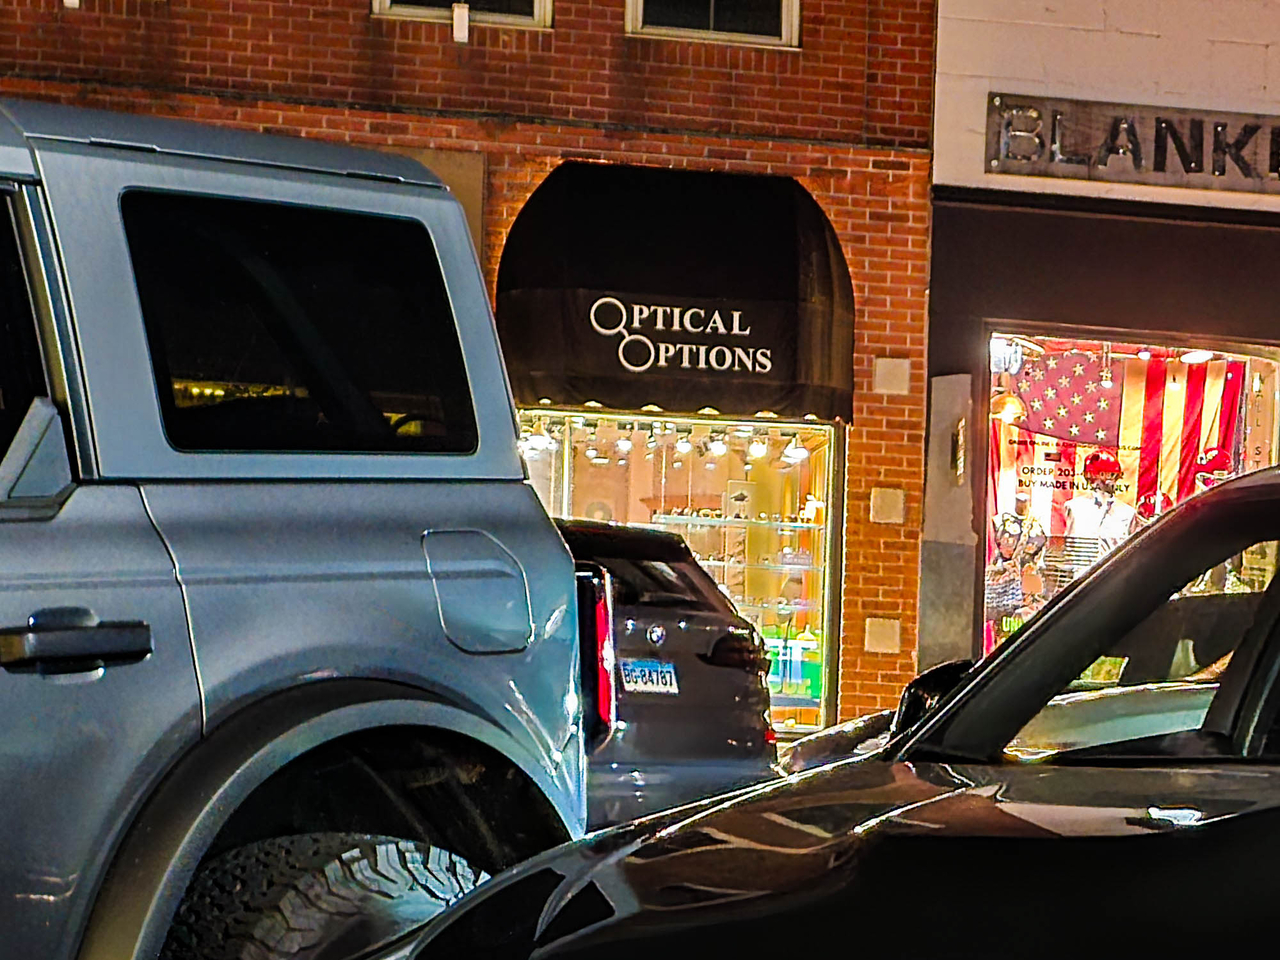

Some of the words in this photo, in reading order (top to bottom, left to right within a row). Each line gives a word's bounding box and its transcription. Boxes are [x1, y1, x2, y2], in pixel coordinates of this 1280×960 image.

[590, 297, 751, 336] OPTICAL
[618, 334, 773, 374] OPTIONS
[1018, 478, 1037, 488] BUY
[1039, 480, 1067, 490] MADE
[1069, 481, 1079, 491] IN
